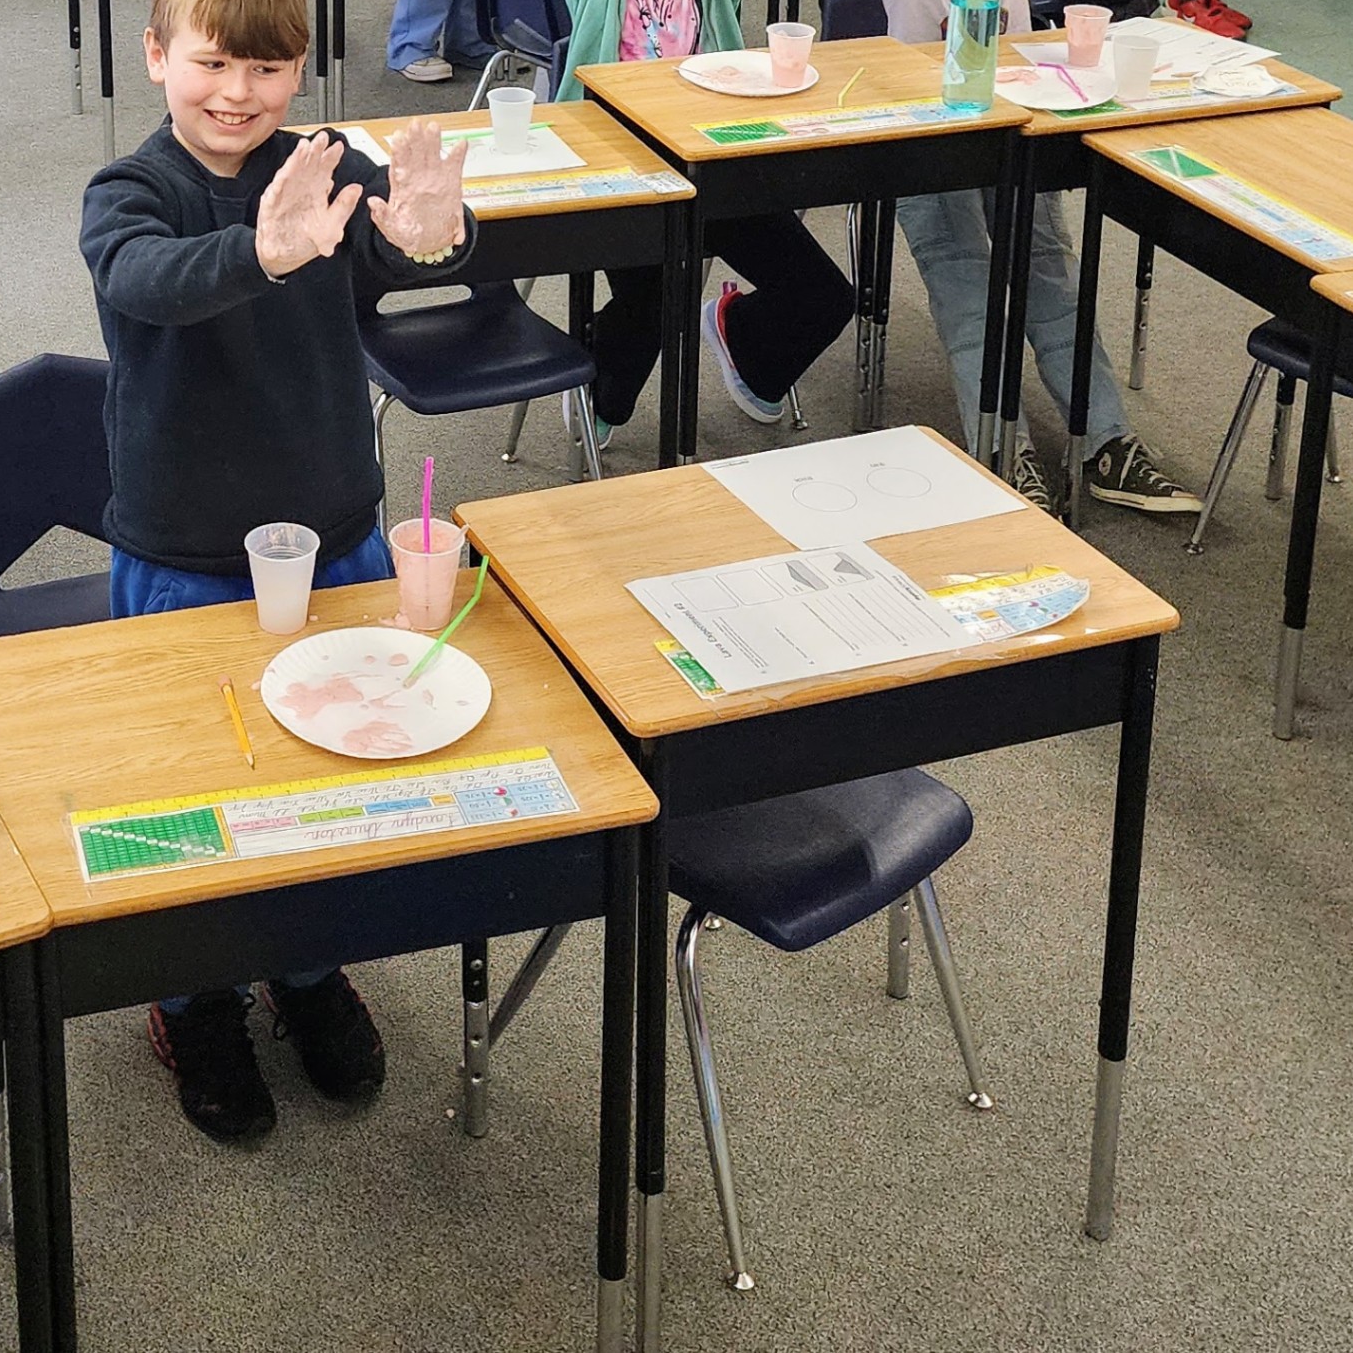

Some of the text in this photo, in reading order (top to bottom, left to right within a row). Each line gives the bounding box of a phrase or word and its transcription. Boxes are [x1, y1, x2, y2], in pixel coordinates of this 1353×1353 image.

[674, 602, 733, 660] Lava Experiment #2
